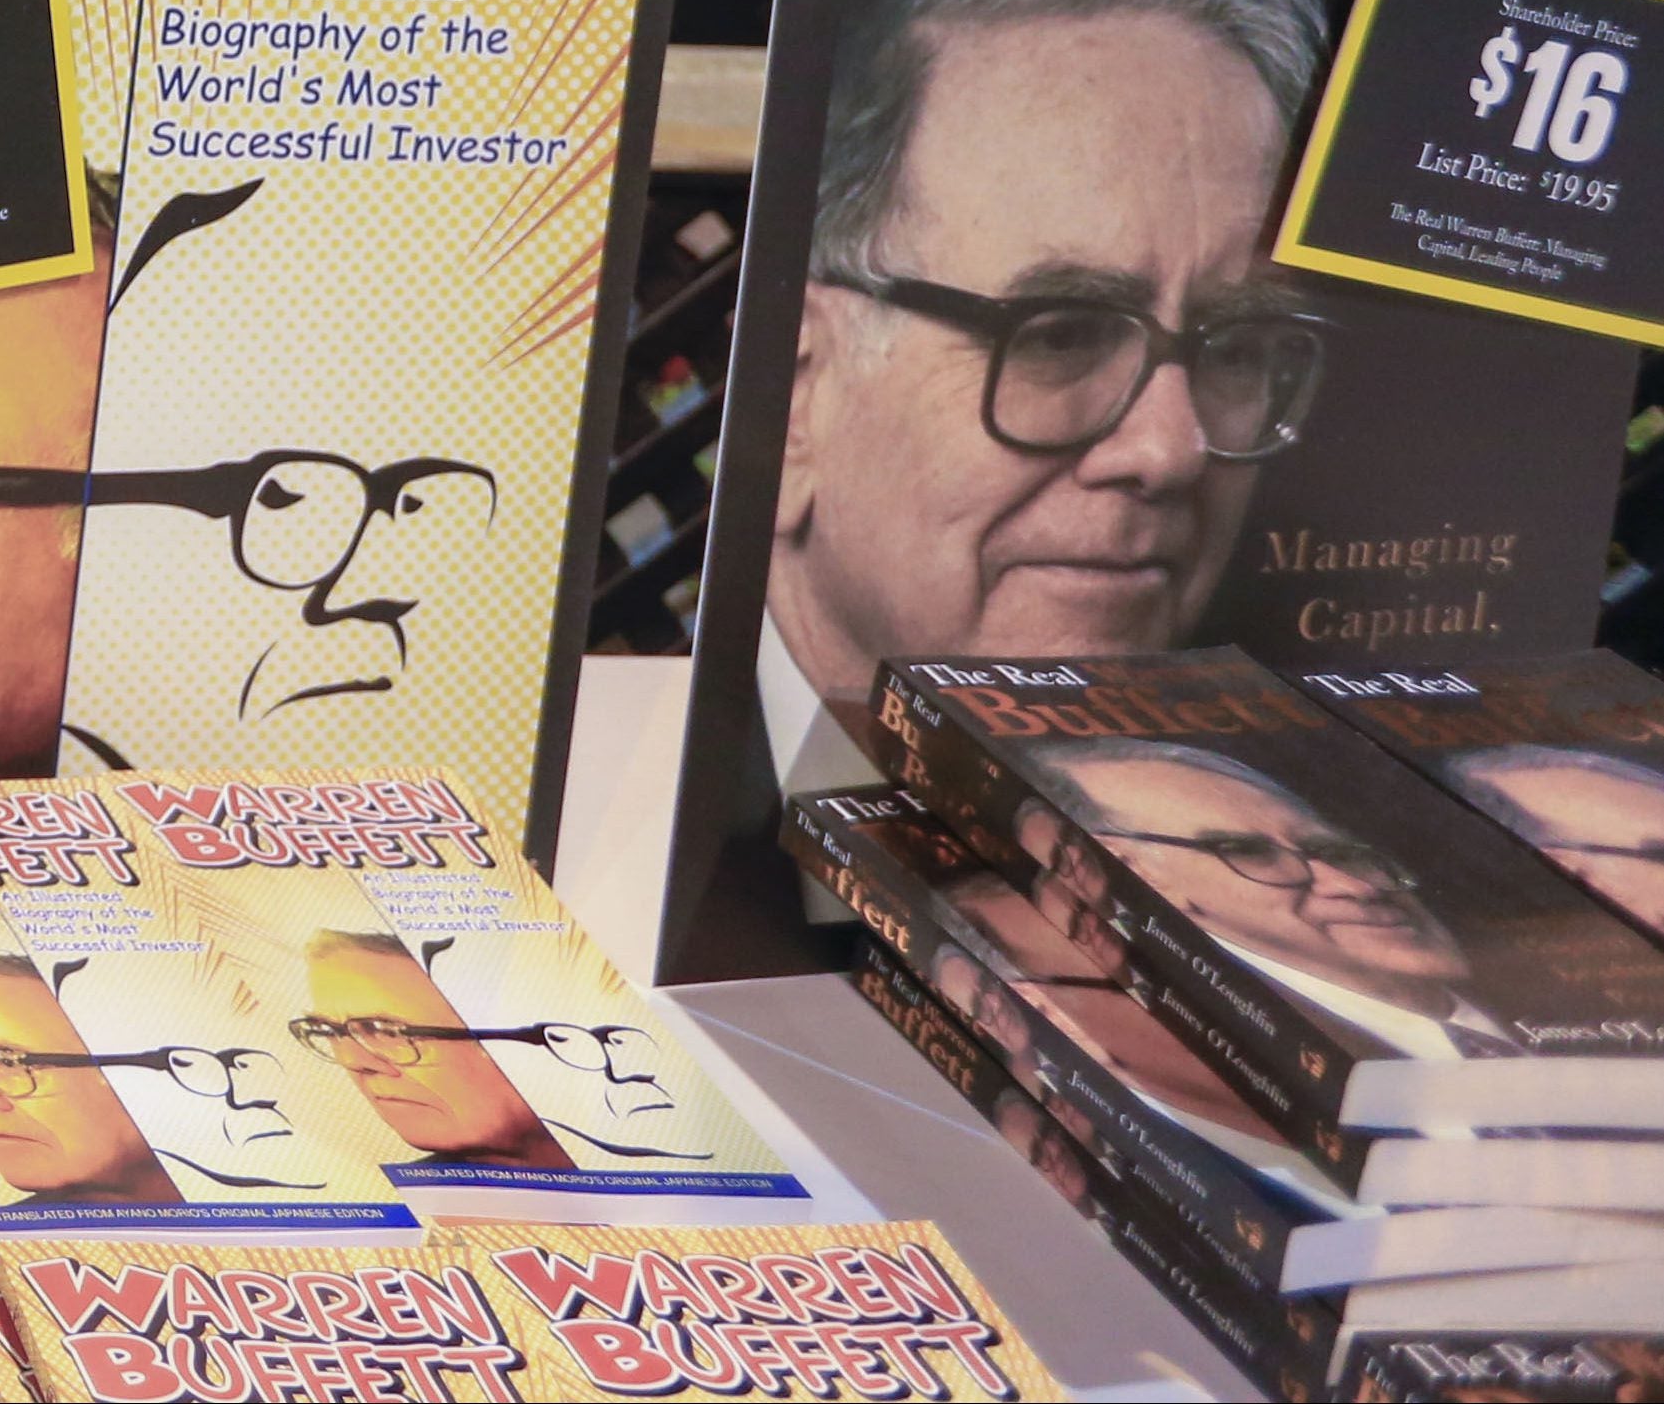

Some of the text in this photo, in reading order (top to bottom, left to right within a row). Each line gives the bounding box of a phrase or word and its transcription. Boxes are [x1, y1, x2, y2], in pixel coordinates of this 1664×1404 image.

[161, 8, 509, 61] Biography of the
[1593, 19, 1639, 47] Price:
[157, 65, 442, 107] World's Most
[1469, 26, 1629, 163] $16
[148, 121, 567, 164] Successful Investor
[1416, 142, 1619, 212] List Price: $19.95
[1391, 202, 1412, 222] The
[1415, 209, 1444, 229] Real
[1447, 215, 1492, 240] Warren
[1543, 238, 1607, 268] Managing
[1469, 246, 1519, 274] Leading
[1522, 256, 1563, 281] People
[1260, 522, 1516, 577] Managing
[910, 663, 1088, 688] The Real
[1141, 915, 1188, 961] James
[76, 1208, 113, 1219] FROM
[212, 1208, 269, 1218] ORIGINAL
[272, 1209, 331, 1219] JAPANESE
[333, 1209, 384, 1219] EDITION
